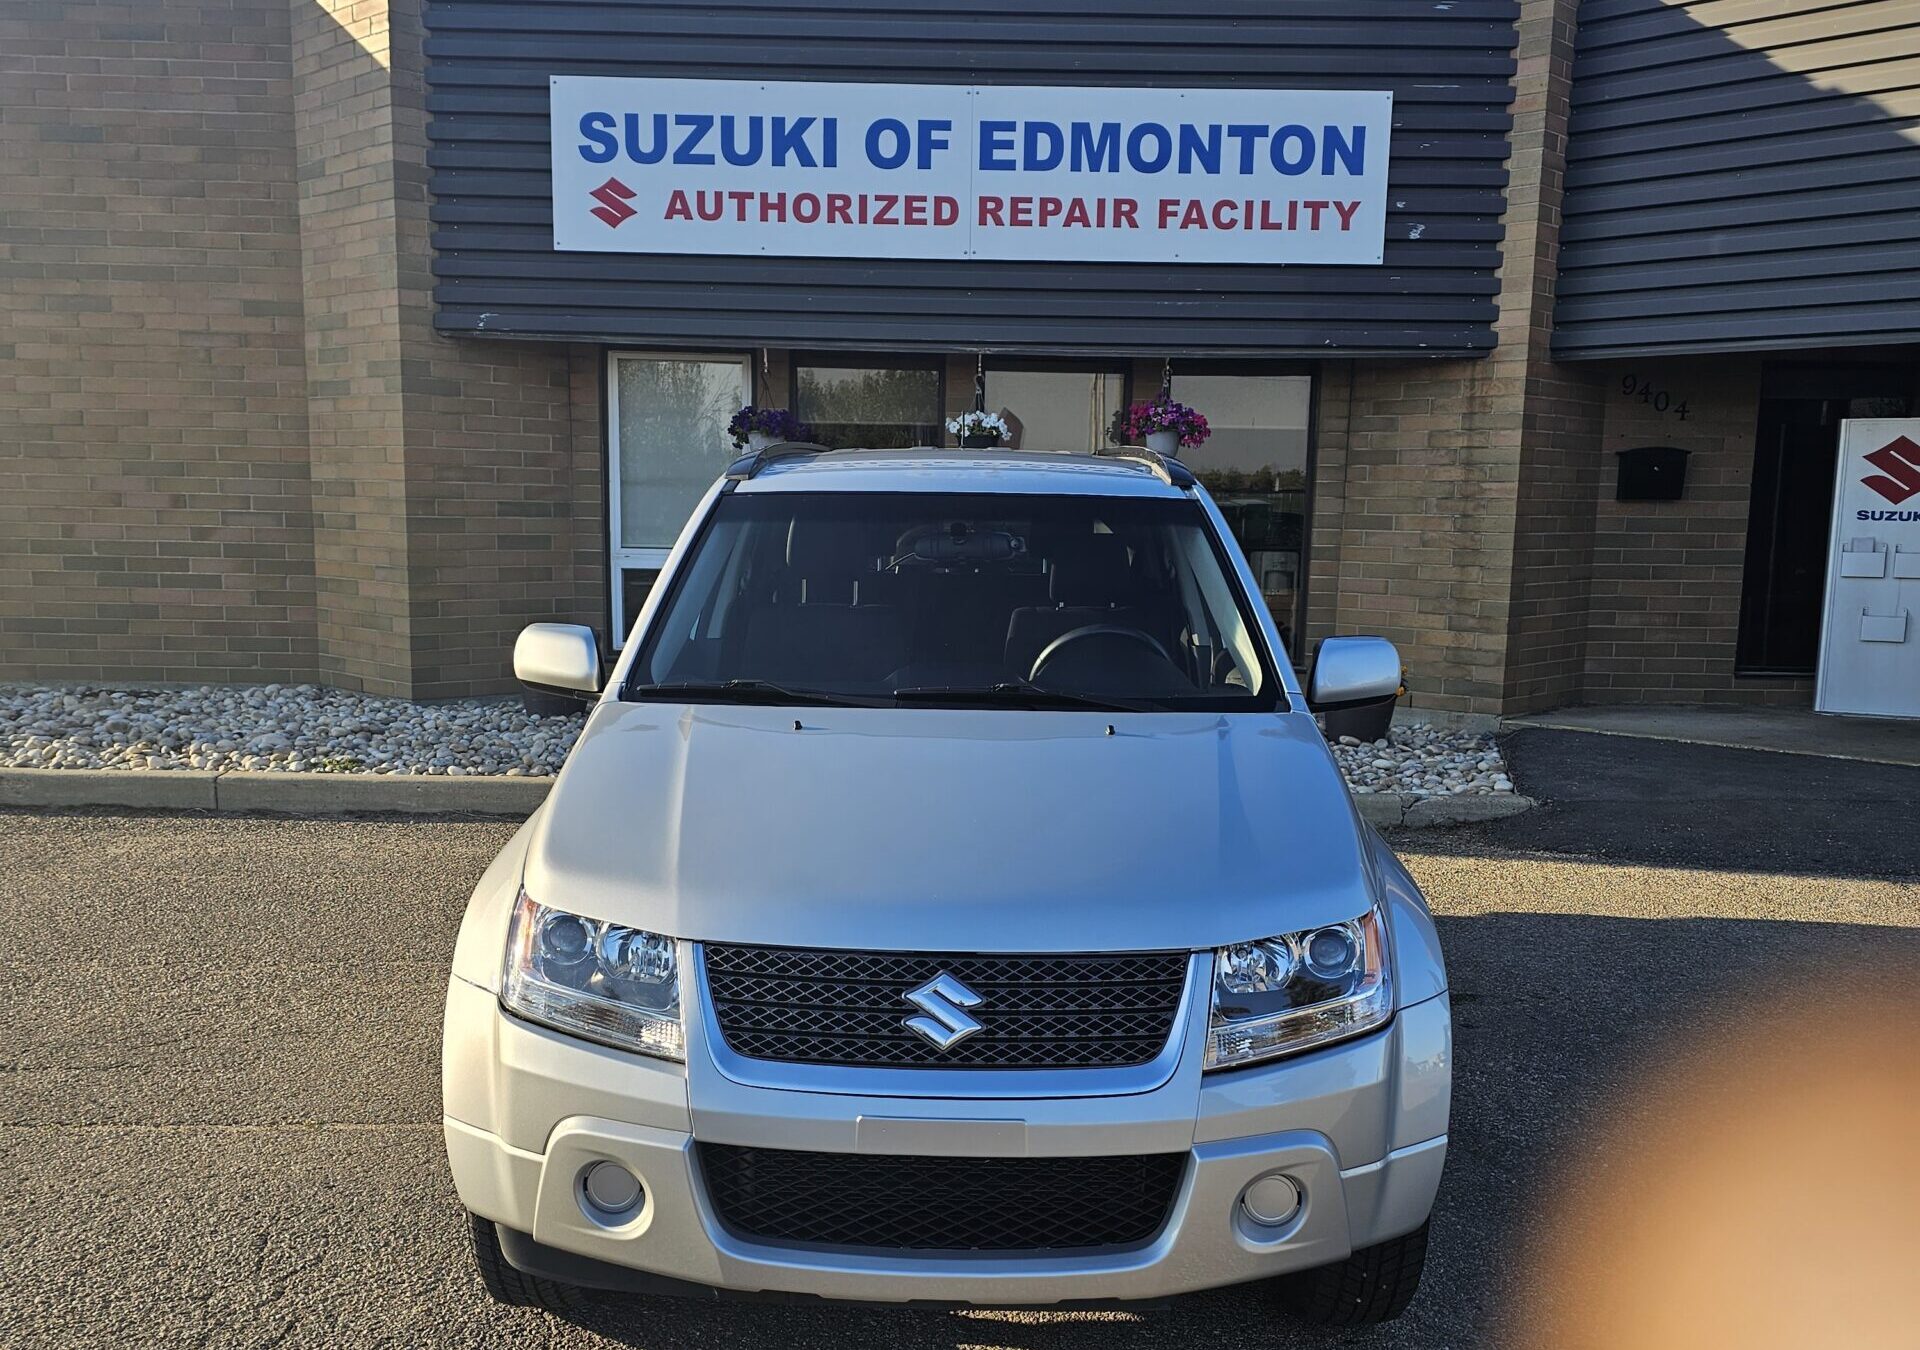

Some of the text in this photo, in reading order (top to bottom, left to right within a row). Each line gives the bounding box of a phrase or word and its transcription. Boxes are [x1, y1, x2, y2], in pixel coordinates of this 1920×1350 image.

[577, 111, 1367, 177] SUZUKI OF EDMONTON
[663, 189, 1362, 231] AUTHORIZED REPAIR FACILITY
[1622, 374, 1690, 421] 9404
